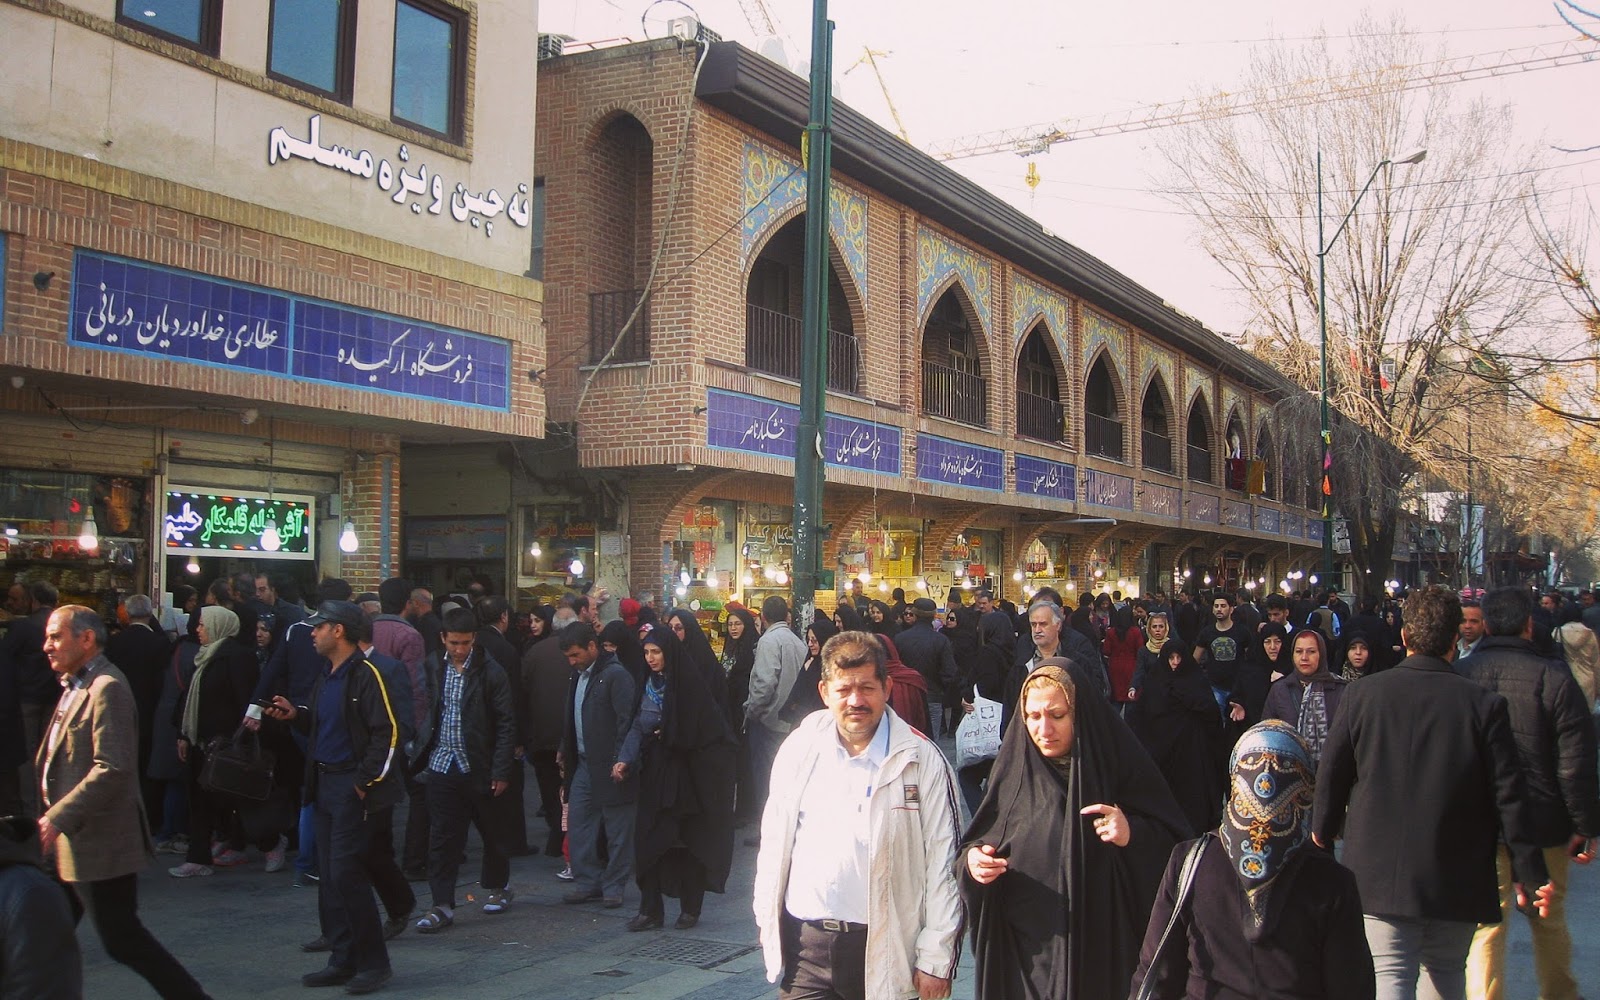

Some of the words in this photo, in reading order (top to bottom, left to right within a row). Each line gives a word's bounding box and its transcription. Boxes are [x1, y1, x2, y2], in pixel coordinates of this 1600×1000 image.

[268, 113, 374, 178] مسلم
[378, 143, 444, 214] ویژه
[84, 282, 135, 344] دریانی
[136, 303, 225, 349] خداوردیان
[223, 318, 279, 359] عطاری
[336, 329, 411, 383] ارکیده
[410, 338, 474, 385] فروشگاه
[739, 419, 758, 446] ناصر
[756, 407, 786, 450] خشکبار
[836, 425, 859, 463] کیان
[852, 431, 881, 461] فروشگاه
[961, 454, 983, 479] فروشگاه
[200, 504, 249, 542] قلمکار
